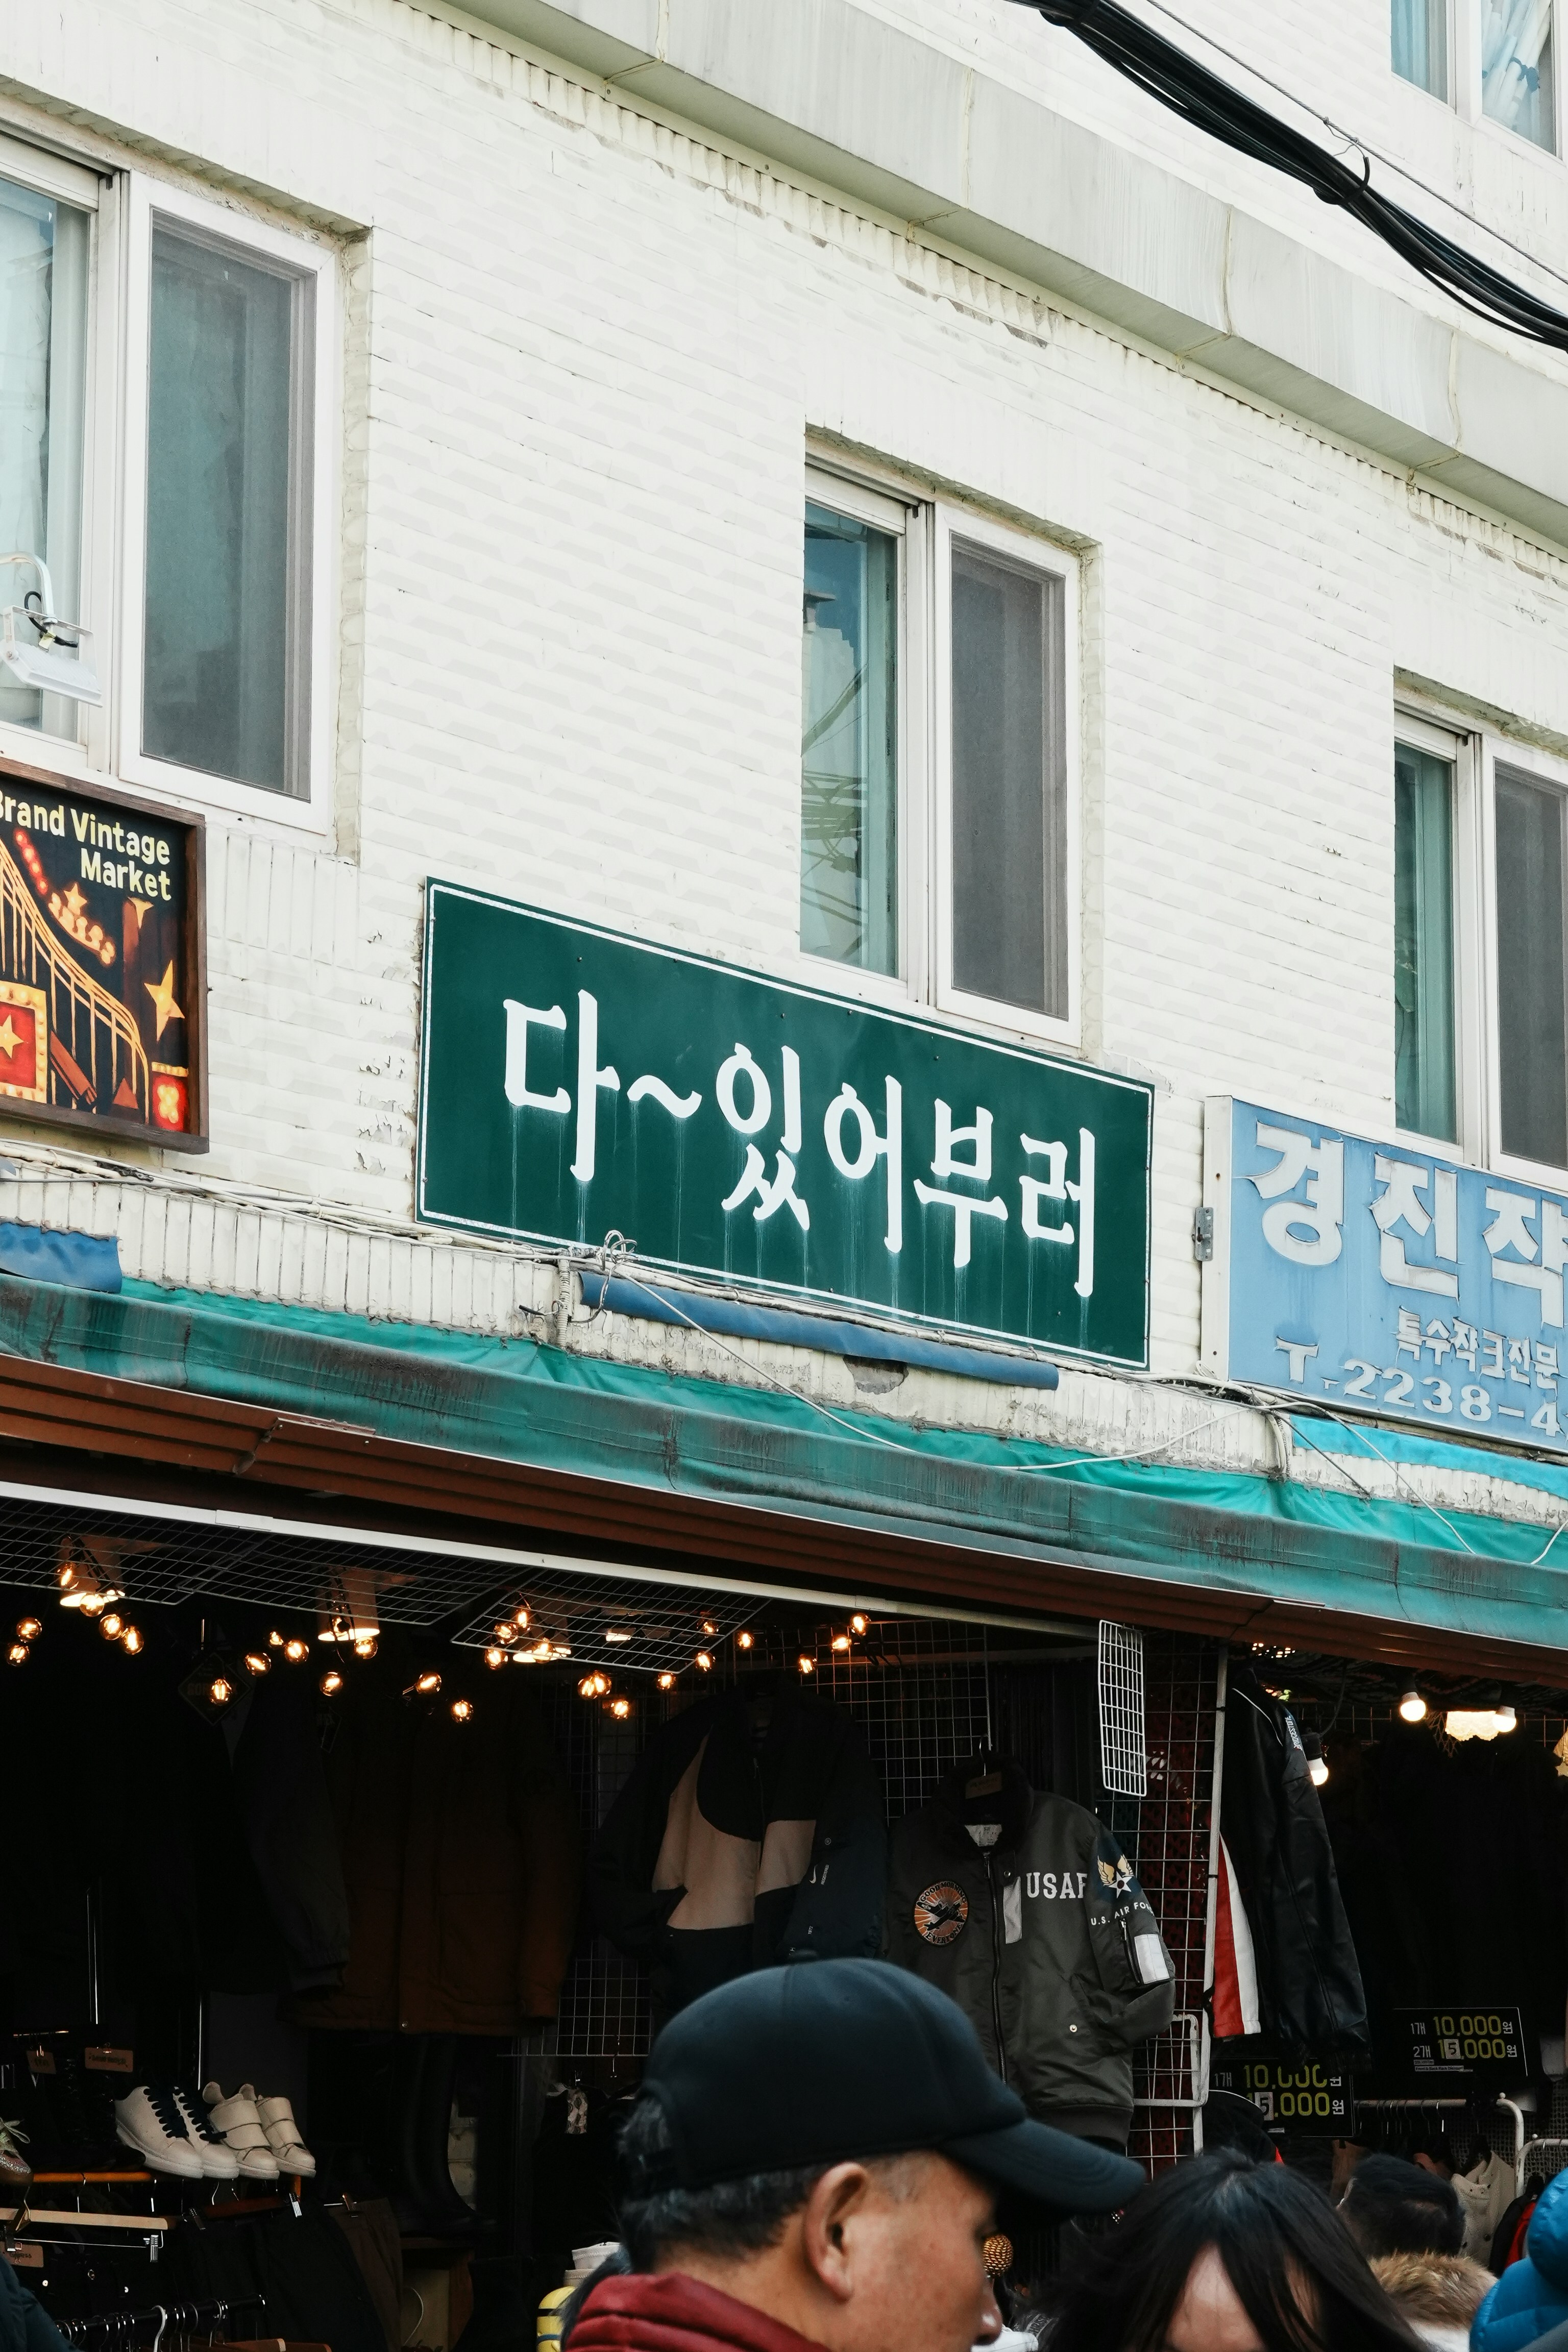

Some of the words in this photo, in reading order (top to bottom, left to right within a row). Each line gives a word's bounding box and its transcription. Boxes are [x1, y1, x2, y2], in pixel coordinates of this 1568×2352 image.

[0, 790, 65, 837] rand
[70, 808, 170, 865] Vintage
[81, 848, 172, 901] Market
[919, 1883, 940, 1902] GOOD
[939, 1881, 967, 1903] MORNING
[1026, 1872, 1088, 1899] USAF
[1091, 1916, 1110, 1926] U.S.
[1114, 1906, 1130, 1919] AIR
[924, 1922, 964, 1945] EVERYONE
